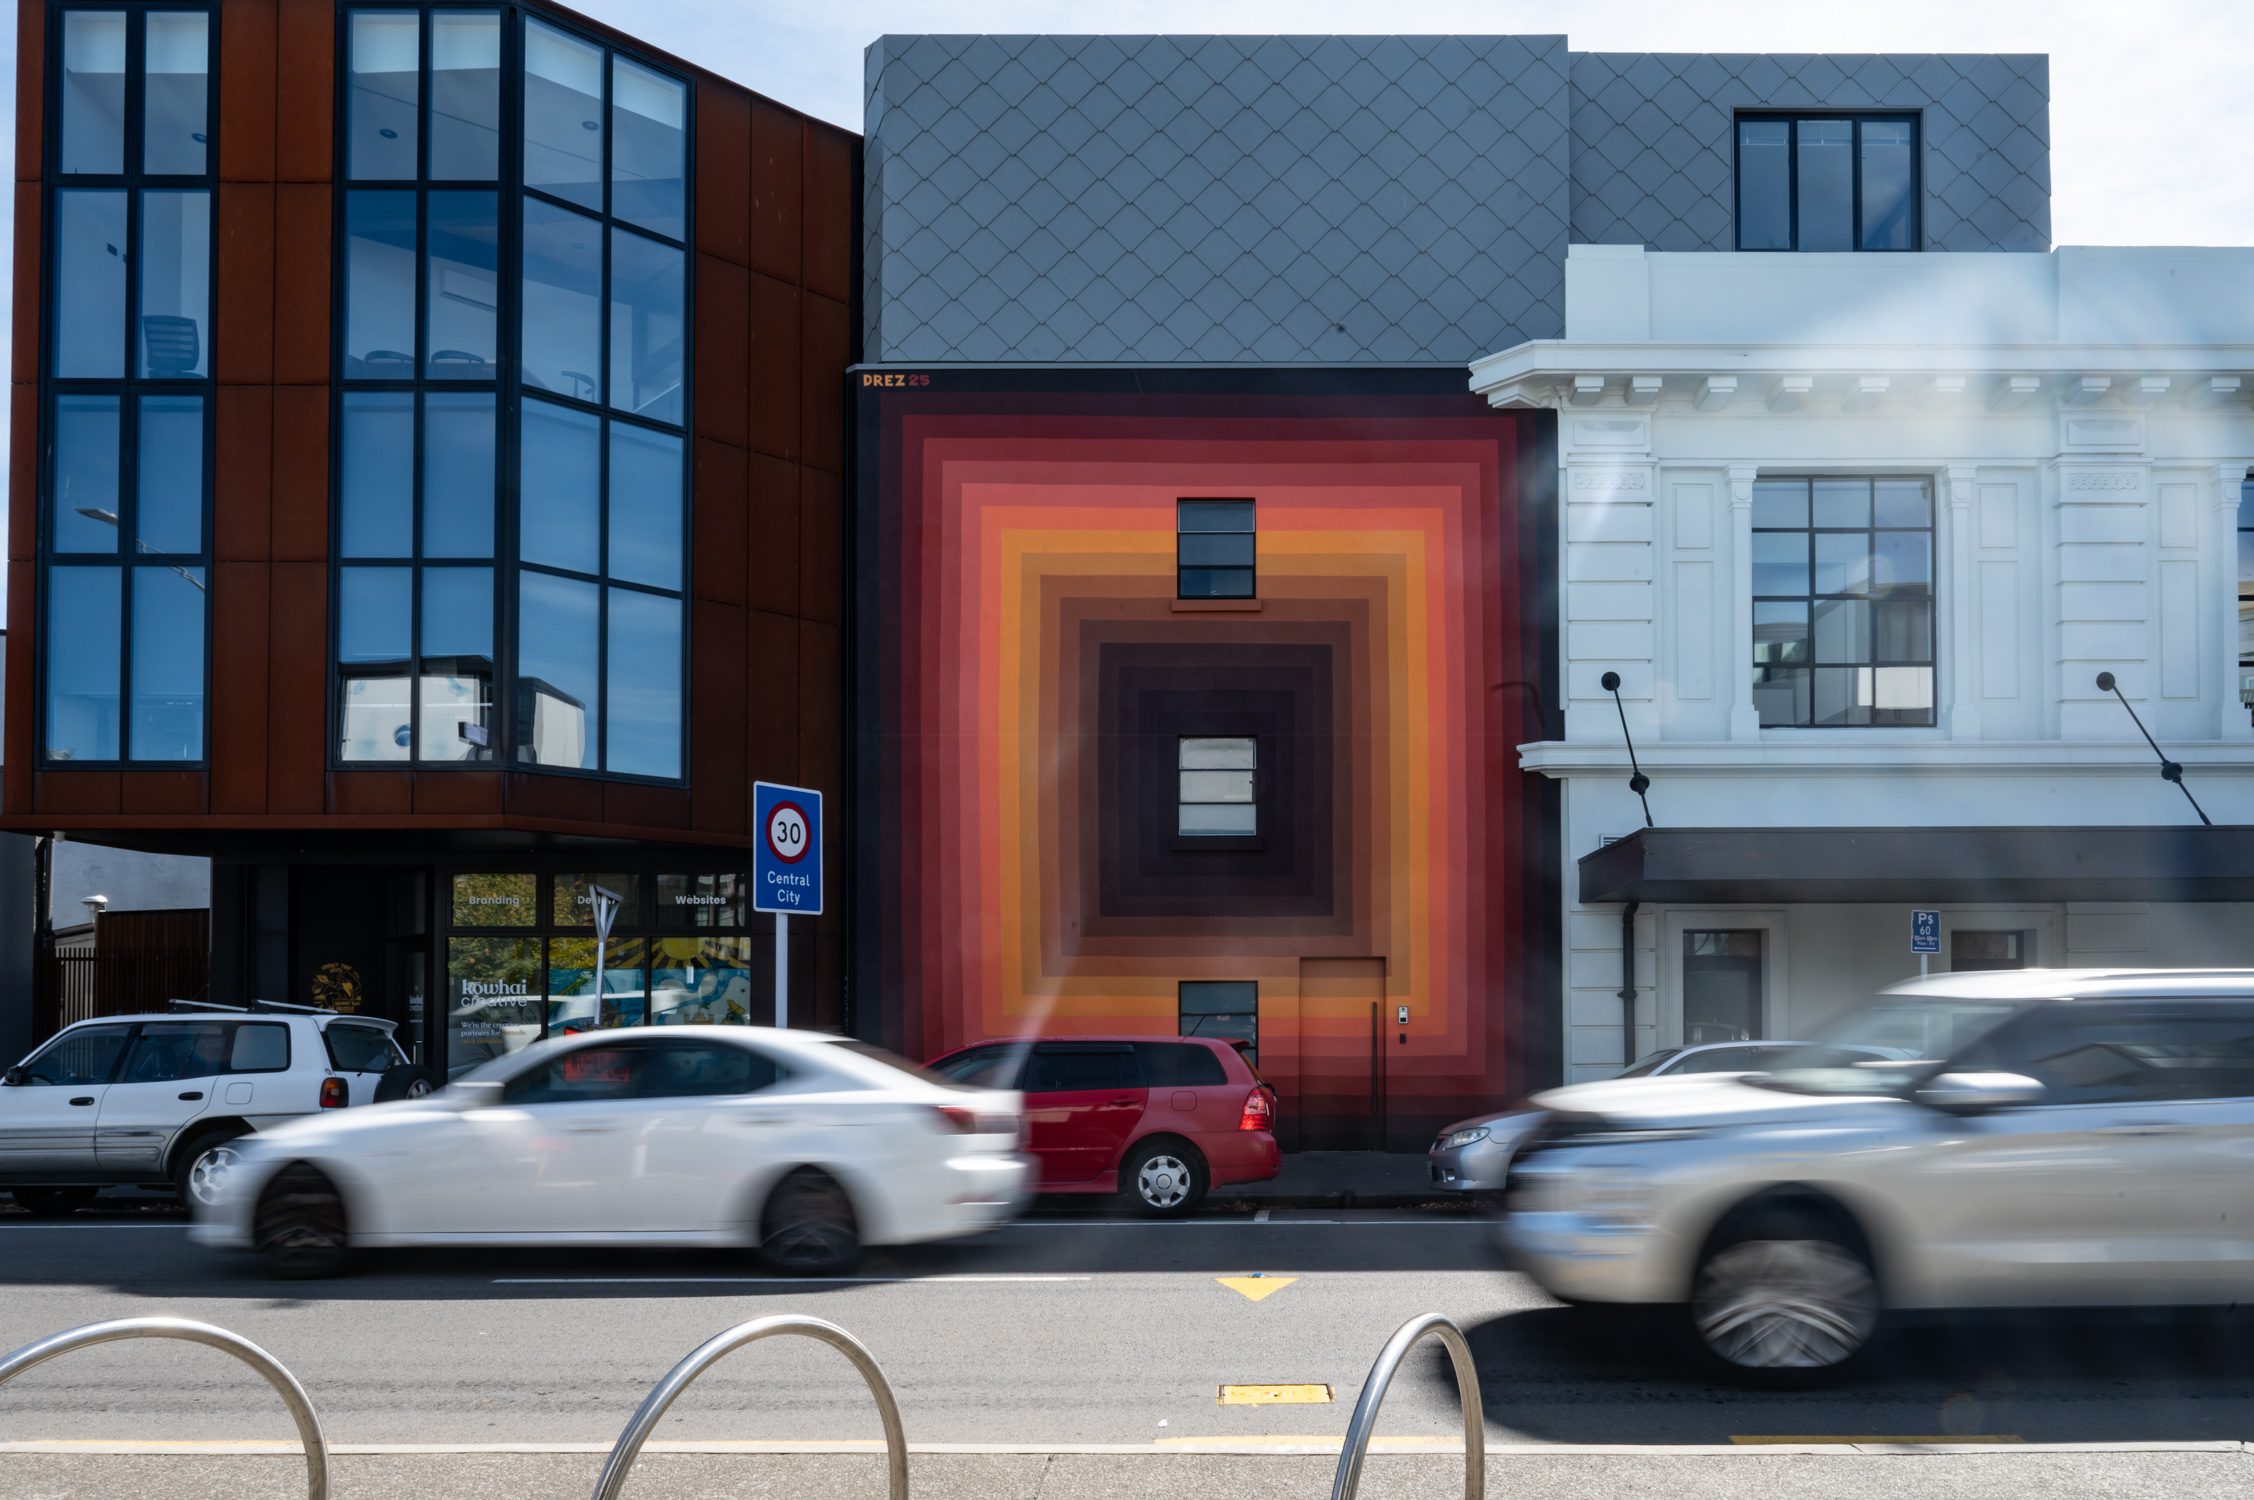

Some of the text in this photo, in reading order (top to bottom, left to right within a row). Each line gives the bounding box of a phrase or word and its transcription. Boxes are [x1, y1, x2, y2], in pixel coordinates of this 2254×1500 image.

[863, 374, 930, 387] DREZ 25
[776, 821, 801, 845] 30
[767, 870, 810, 887] Central
[468, 895, 520, 907] Branding
[577, 895, 616, 905] Dei
[675, 895, 727, 905] Websites
[777, 889, 801, 906] City
[1920, 926, 1931, 935] 60
[462, 978, 527, 995] kōwhai
[461, 996, 528, 1007] creative
[480, 1021, 492, 1029] the
[461, 1029, 490, 1038] partners
[490, 1029, 501, 1037] for
